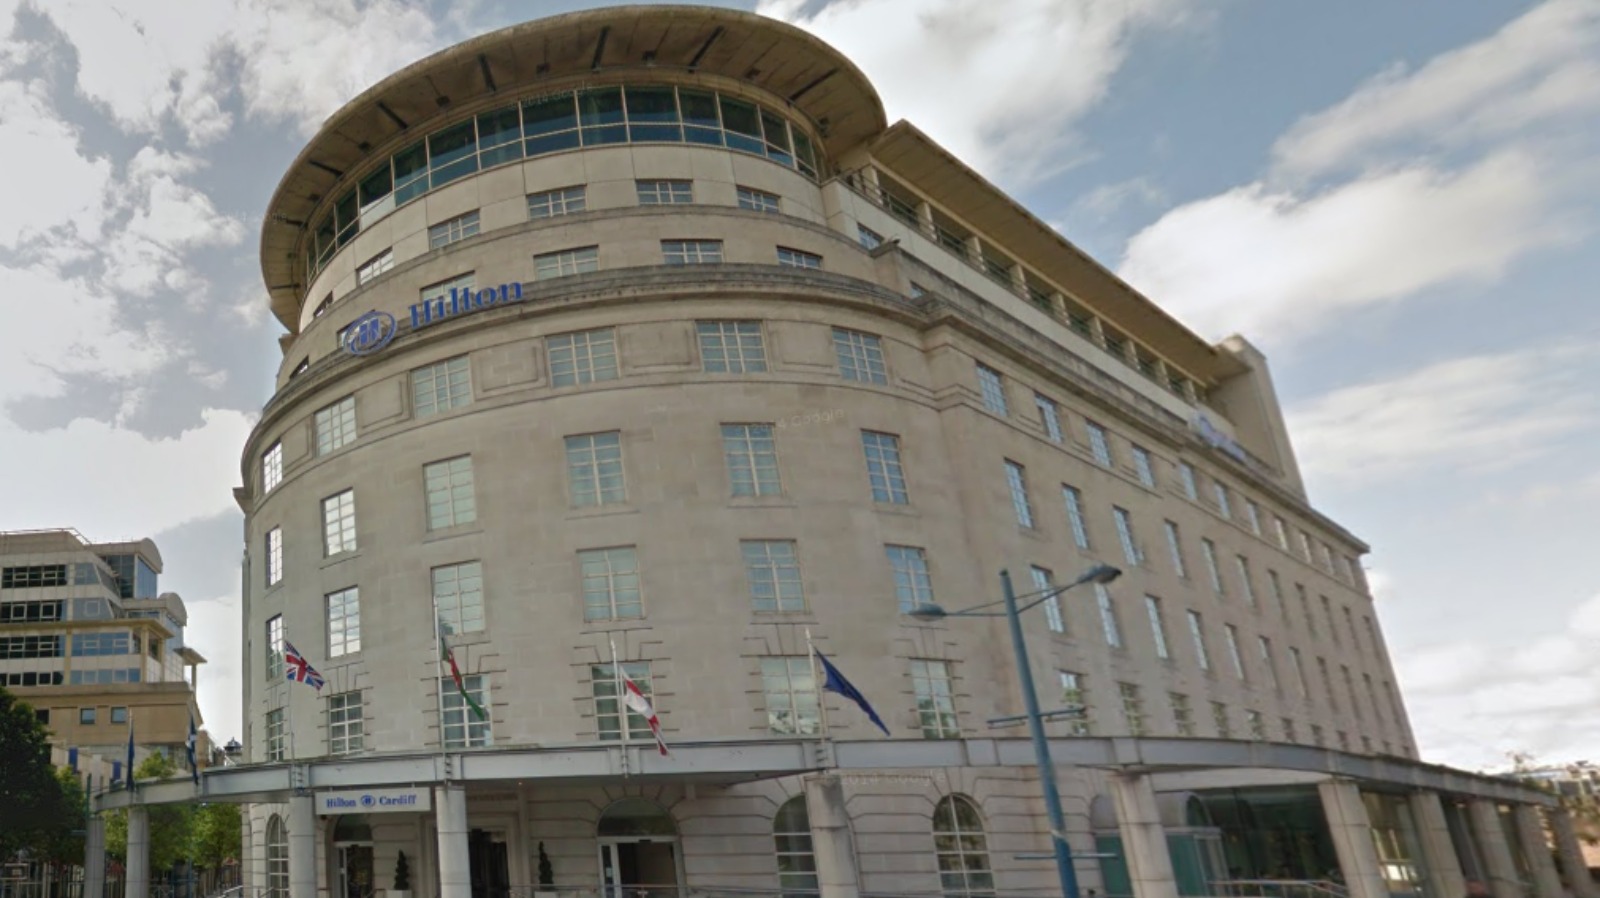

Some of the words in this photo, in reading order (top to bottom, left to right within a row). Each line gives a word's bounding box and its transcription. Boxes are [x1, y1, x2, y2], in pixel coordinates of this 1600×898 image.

[408, 281, 523, 330] Hilton
[326, 796, 357, 809] Hilton
[379, 794, 417, 806] Cardiff
